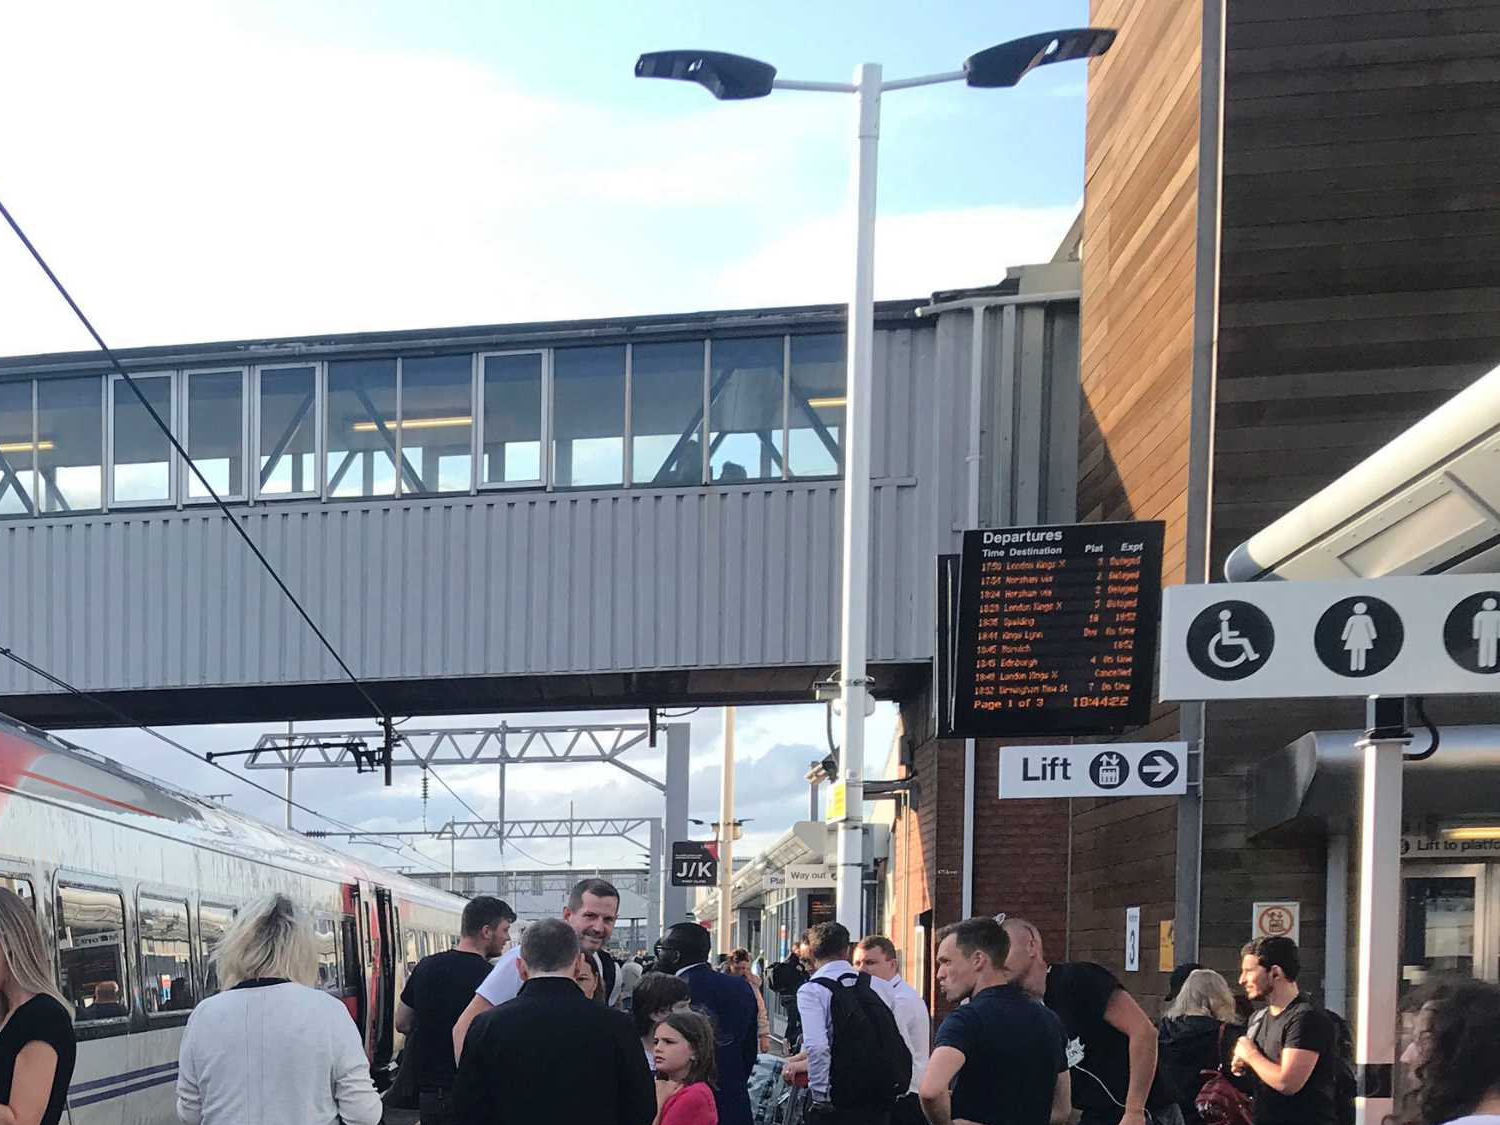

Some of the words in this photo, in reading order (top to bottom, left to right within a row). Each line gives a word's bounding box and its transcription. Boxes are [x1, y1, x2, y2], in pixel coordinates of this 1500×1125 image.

[983, 531, 1063, 546] Departures
[982, 549, 1005, 557] Time
[1008, 546, 1063, 556] Destination
[1084, 544, 1104, 553] Plat
[1121, 542, 1143, 552] Expt
[1006, 561, 1035, 571] London
[1036, 560, 1056, 570] Kings
[1108, 555, 1141, 567] Delayed
[1108, 570, 1141, 582] Delayed
[1107, 585, 1139, 596] Delayed
[1004, 603, 1031, 612] London
[1033, 602, 1054, 613] Kings
[1106, 598, 1138, 609] Delayed
[1003, 616, 1035, 628] Spalding
[1002, 631, 1022, 641] Kings
[1024, 630, 1044, 640] Lynn
[1001, 658, 1038, 669] Edinburgh
[1000, 672, 1027, 682] London
[1028, 670, 1049, 682] Kings
[1094, 667, 1133, 677] Cancelled
[973, 700, 1002, 711] Page
[1018, 698, 1032, 708] of
[1036, 698, 1044, 708] 3
[1022, 757, 1072, 781] Lift
[1418, 839, 1439, 851] Lift
[1444, 840, 1458, 850] to
[676, 861, 712, 878] J/K
[790, 871, 809, 881] Way
[811, 871, 827, 880] out
